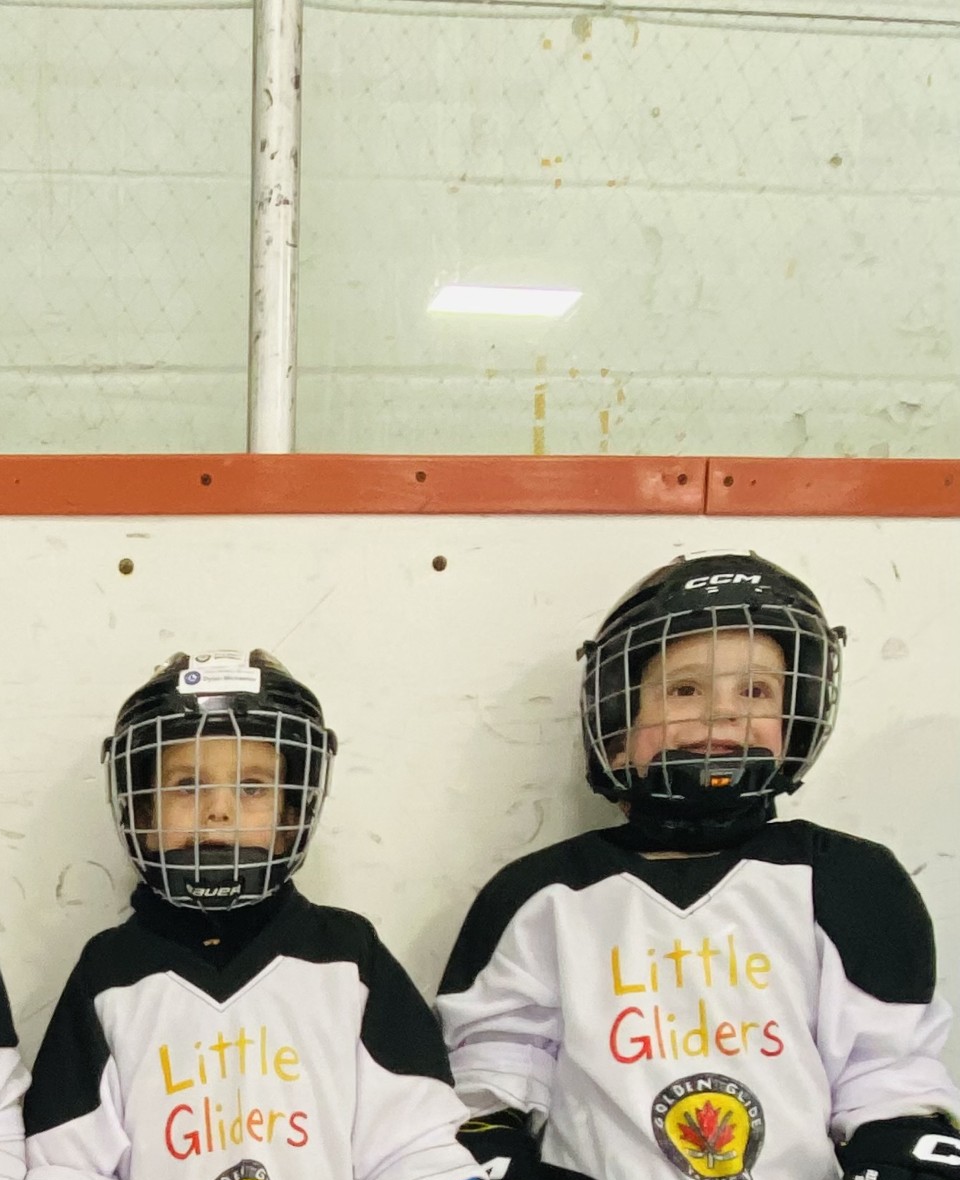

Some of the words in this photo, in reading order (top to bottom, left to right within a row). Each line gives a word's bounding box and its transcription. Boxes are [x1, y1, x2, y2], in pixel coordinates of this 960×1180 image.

[684, 573, 762, 590] CCM
[611, 934, 772, 996] Little
[159, 1025, 301, 1095] Little
[609, 998, 784, 1064] Gliders
[165, 1087, 309, 1160] Gliders
[655, 1078, 712, 1129] GOLDEN
[726, 1083, 761, 1128] GLIDE
